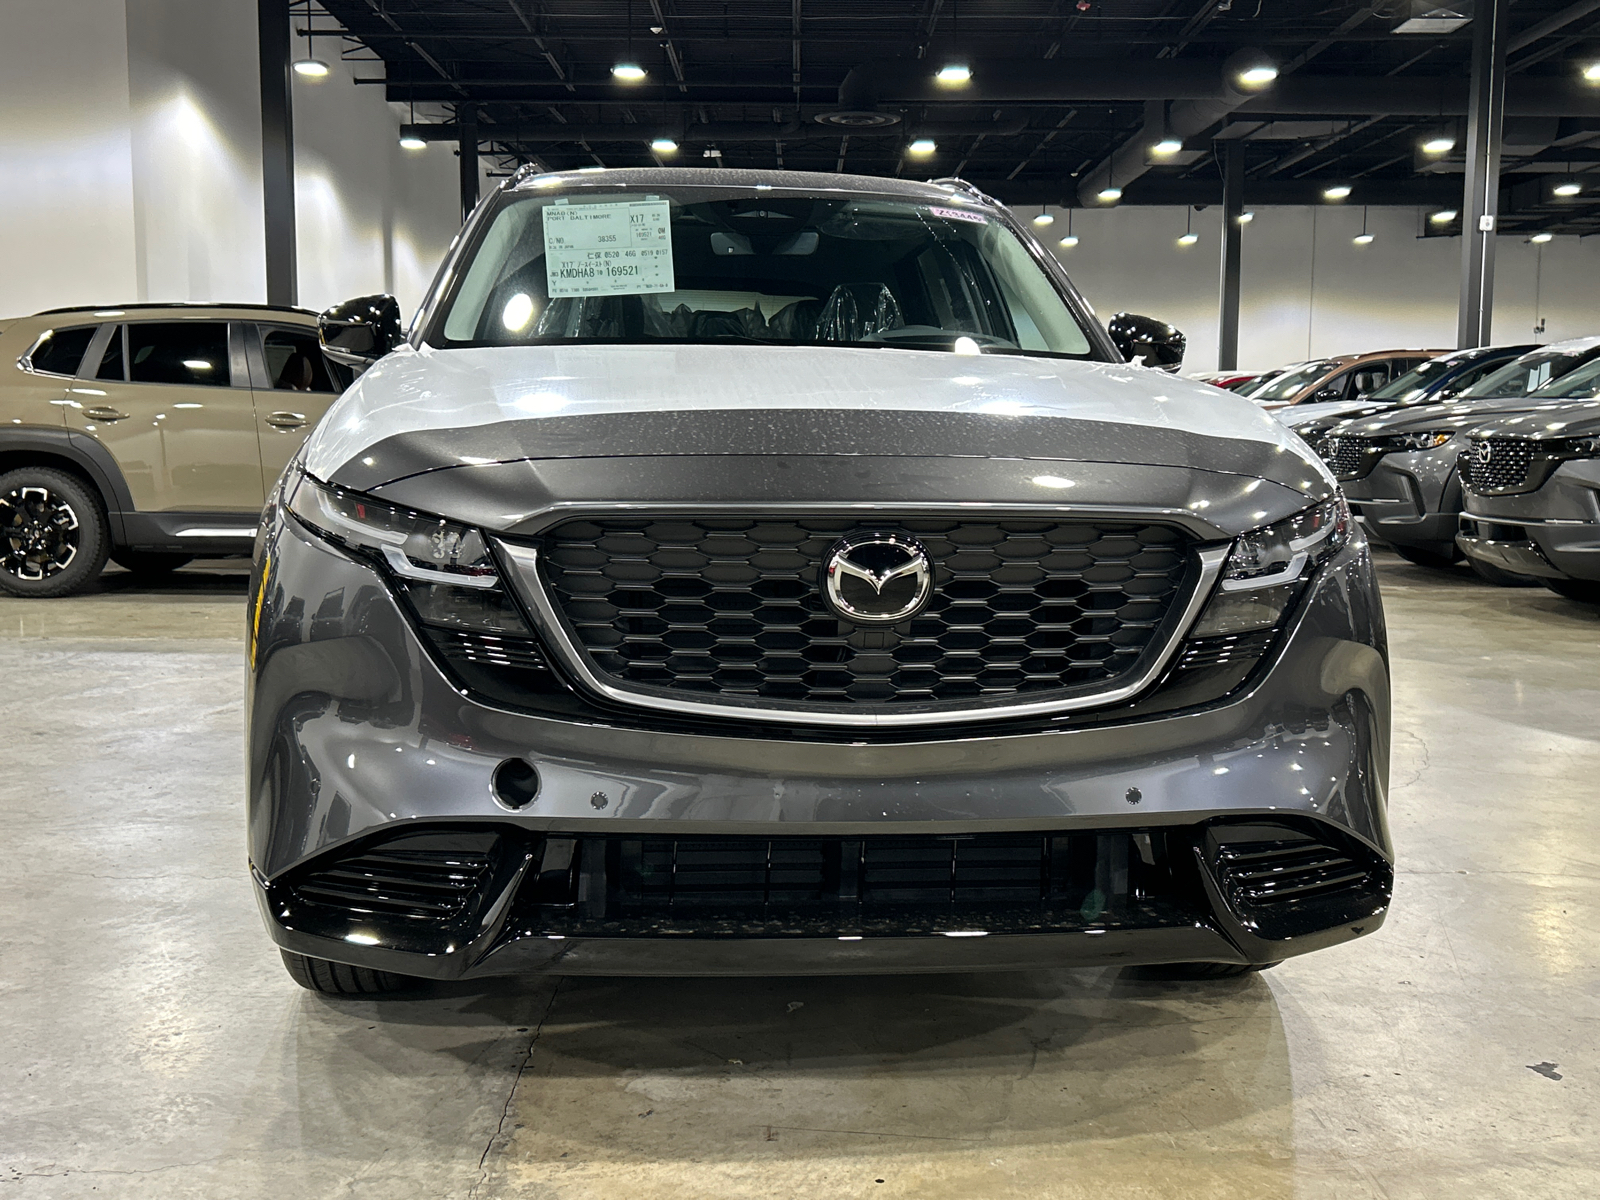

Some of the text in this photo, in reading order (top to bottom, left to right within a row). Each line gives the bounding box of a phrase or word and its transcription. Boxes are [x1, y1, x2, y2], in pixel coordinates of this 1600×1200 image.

[630, 213, 645, 224] X17
[597, 234, 617, 243] 38355
[604, 250, 620, 259] 0520
[624, 250, 637, 258] 46G
[641, 249, 654, 257] 0519
[560, 267, 595, 279] KMDHA8
[606, 265, 639, 277] 169521
